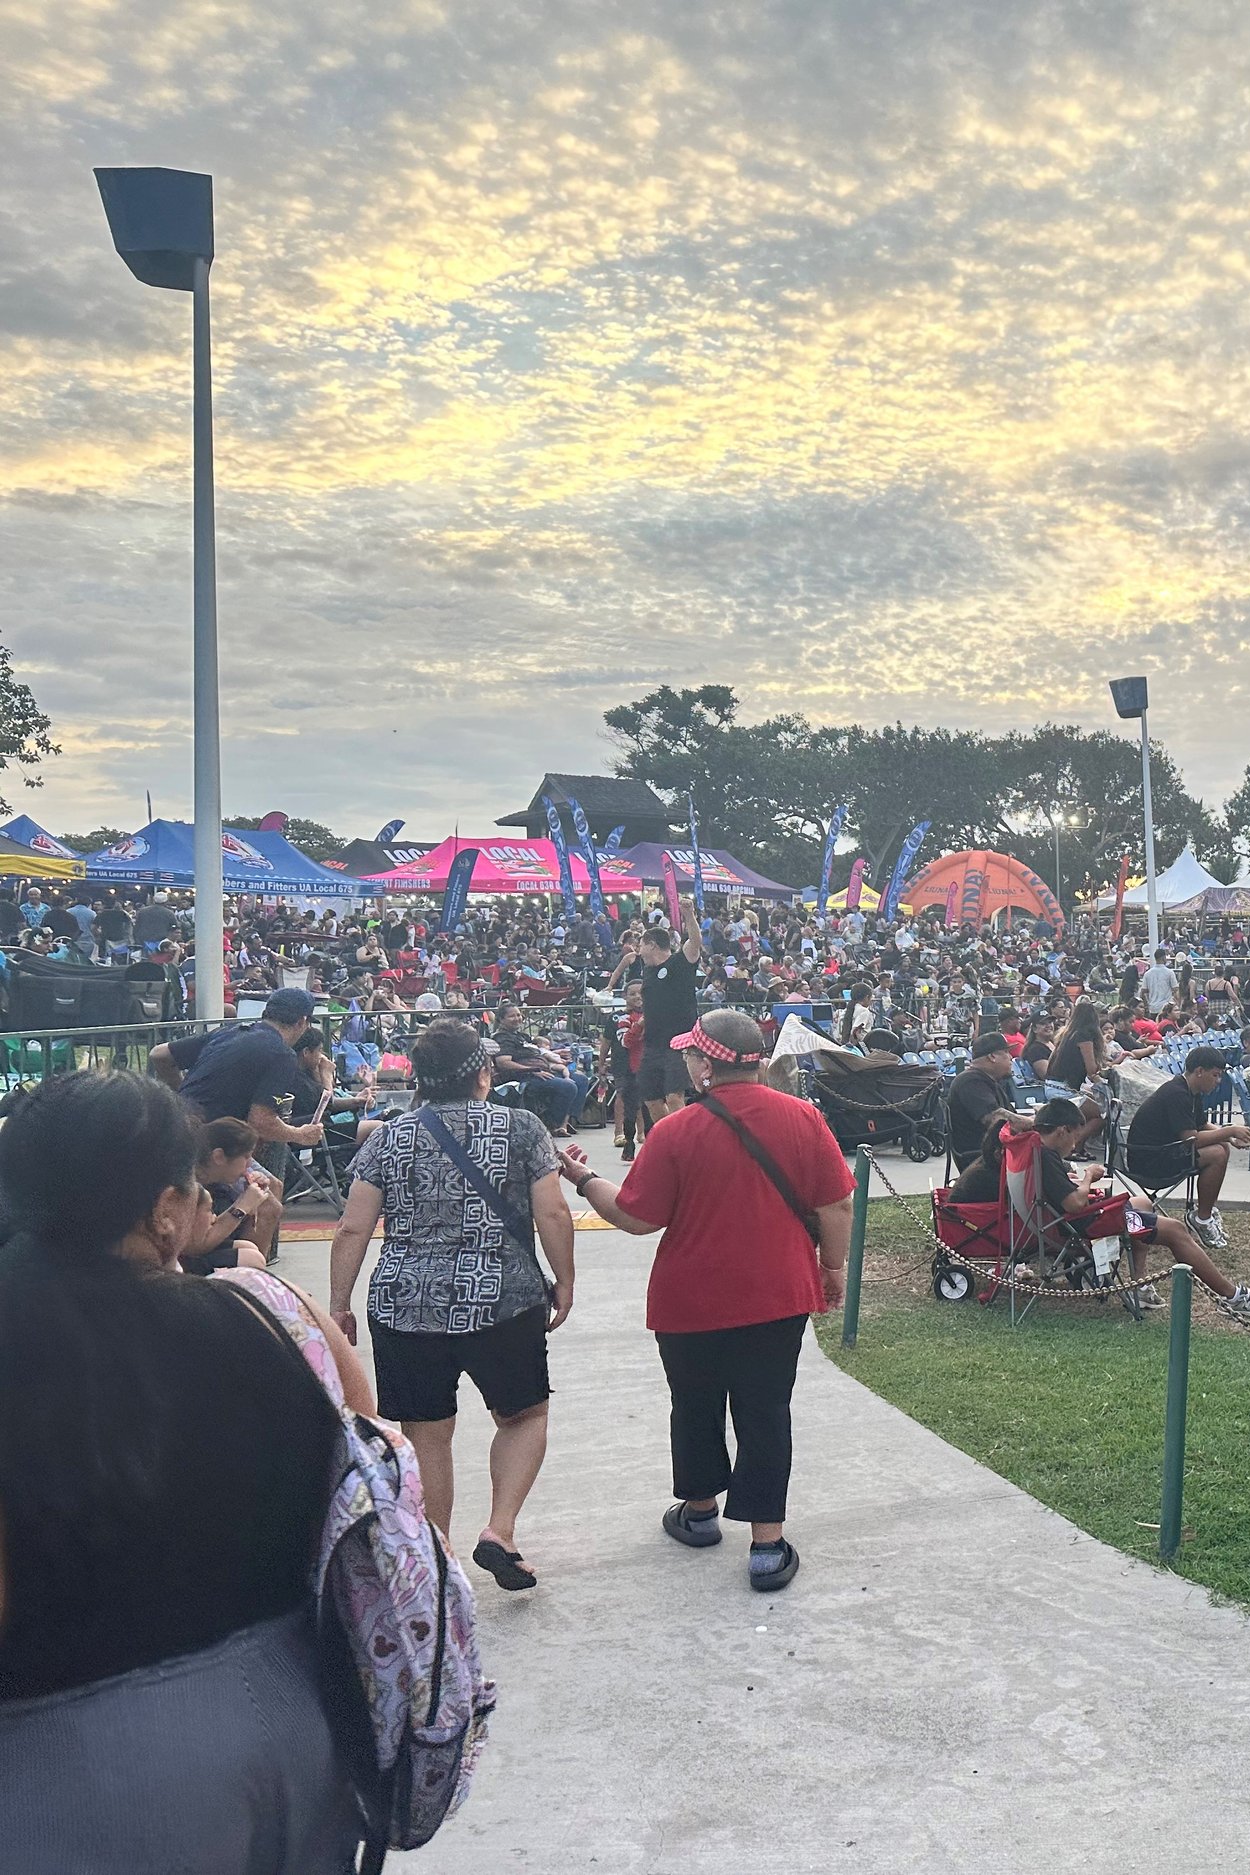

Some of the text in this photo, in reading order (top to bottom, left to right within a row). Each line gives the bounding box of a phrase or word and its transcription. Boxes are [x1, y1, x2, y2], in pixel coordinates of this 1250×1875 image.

[479, 846, 546, 862] LOCAL
[223, 878, 353, 894] bers and Fitters UA Local 675
[516, 881, 539, 891] LOCAL
[702, 882, 719, 892] OCAL
